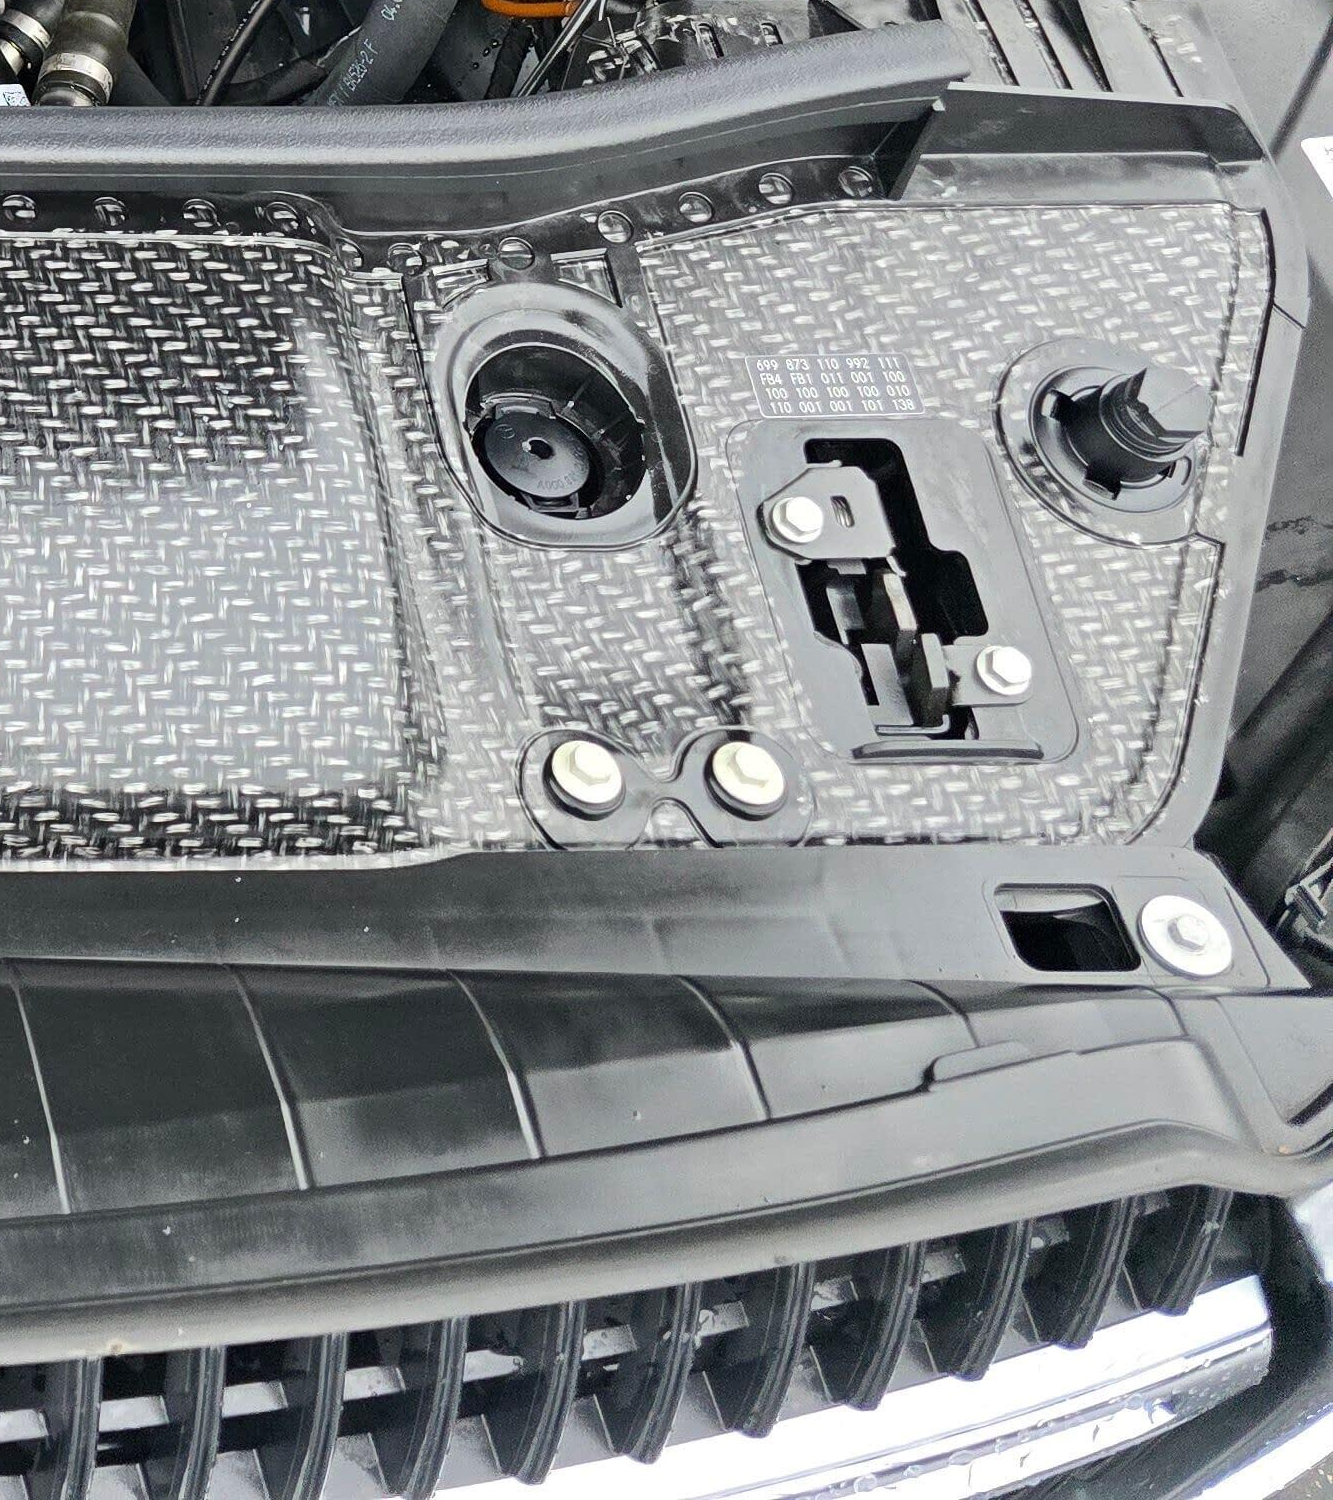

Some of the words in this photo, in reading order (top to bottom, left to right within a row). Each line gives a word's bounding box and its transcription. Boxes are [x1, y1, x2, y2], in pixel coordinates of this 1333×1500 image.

[756, 359, 779, 371] 699
[786, 359, 810, 370] 873
[817, 358, 839, 370] 110
[846, 358, 869, 369] 992
[878, 357, 900, 369] 111
[760, 373, 783, 385] FB4
[790, 373, 812, 385] FB1
[821, 373, 843, 384] 011
[851, 372, 874, 383] 001
[883, 371, 906, 383] 100
[765, 388, 788, 400] 100
[796, 388, 817, 399] 100
[827, 387, 848, 398] 100
[857, 386, 878, 398] 100
[887, 386, 910, 397] 010
[769, 403, 792, 414] 110
[799, 402, 822, 413] 001
[829, 402, 853, 412] 001
[861, 401, 883, 412] 101
[892, 400, 915, 411] 138
